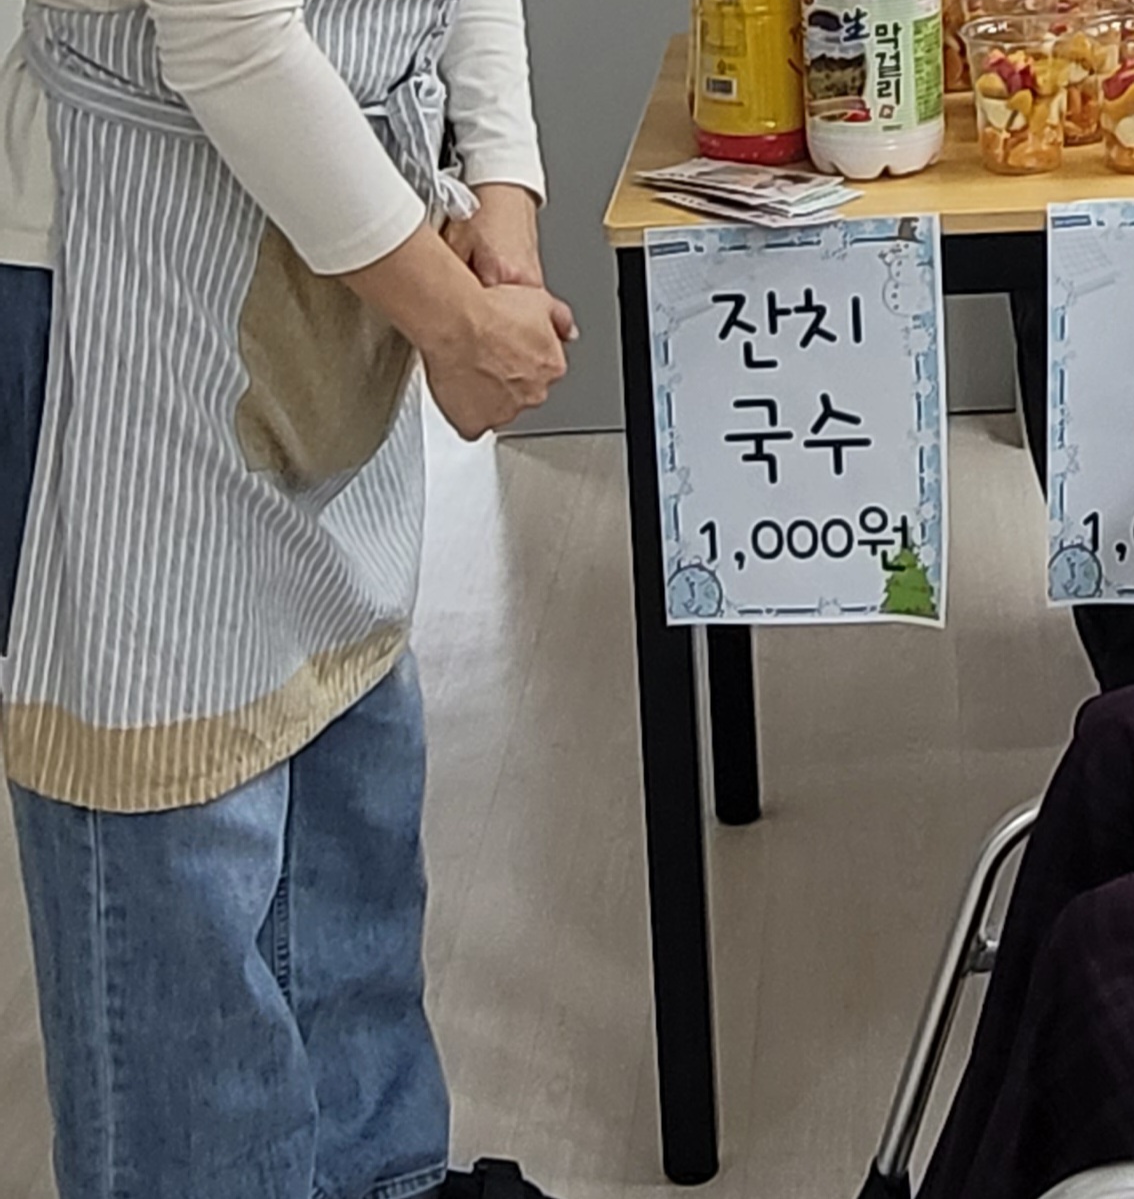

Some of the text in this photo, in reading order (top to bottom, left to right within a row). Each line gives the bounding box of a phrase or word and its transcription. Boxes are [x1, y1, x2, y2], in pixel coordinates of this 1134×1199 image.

[842, 7, 871, 42] 生
[874, 21, 903, 106] 막걸리
[711, 288, 863, 369] 잔치
[723, 392, 873, 485] 국수
[699, 505, 908, 572] 1,000원
